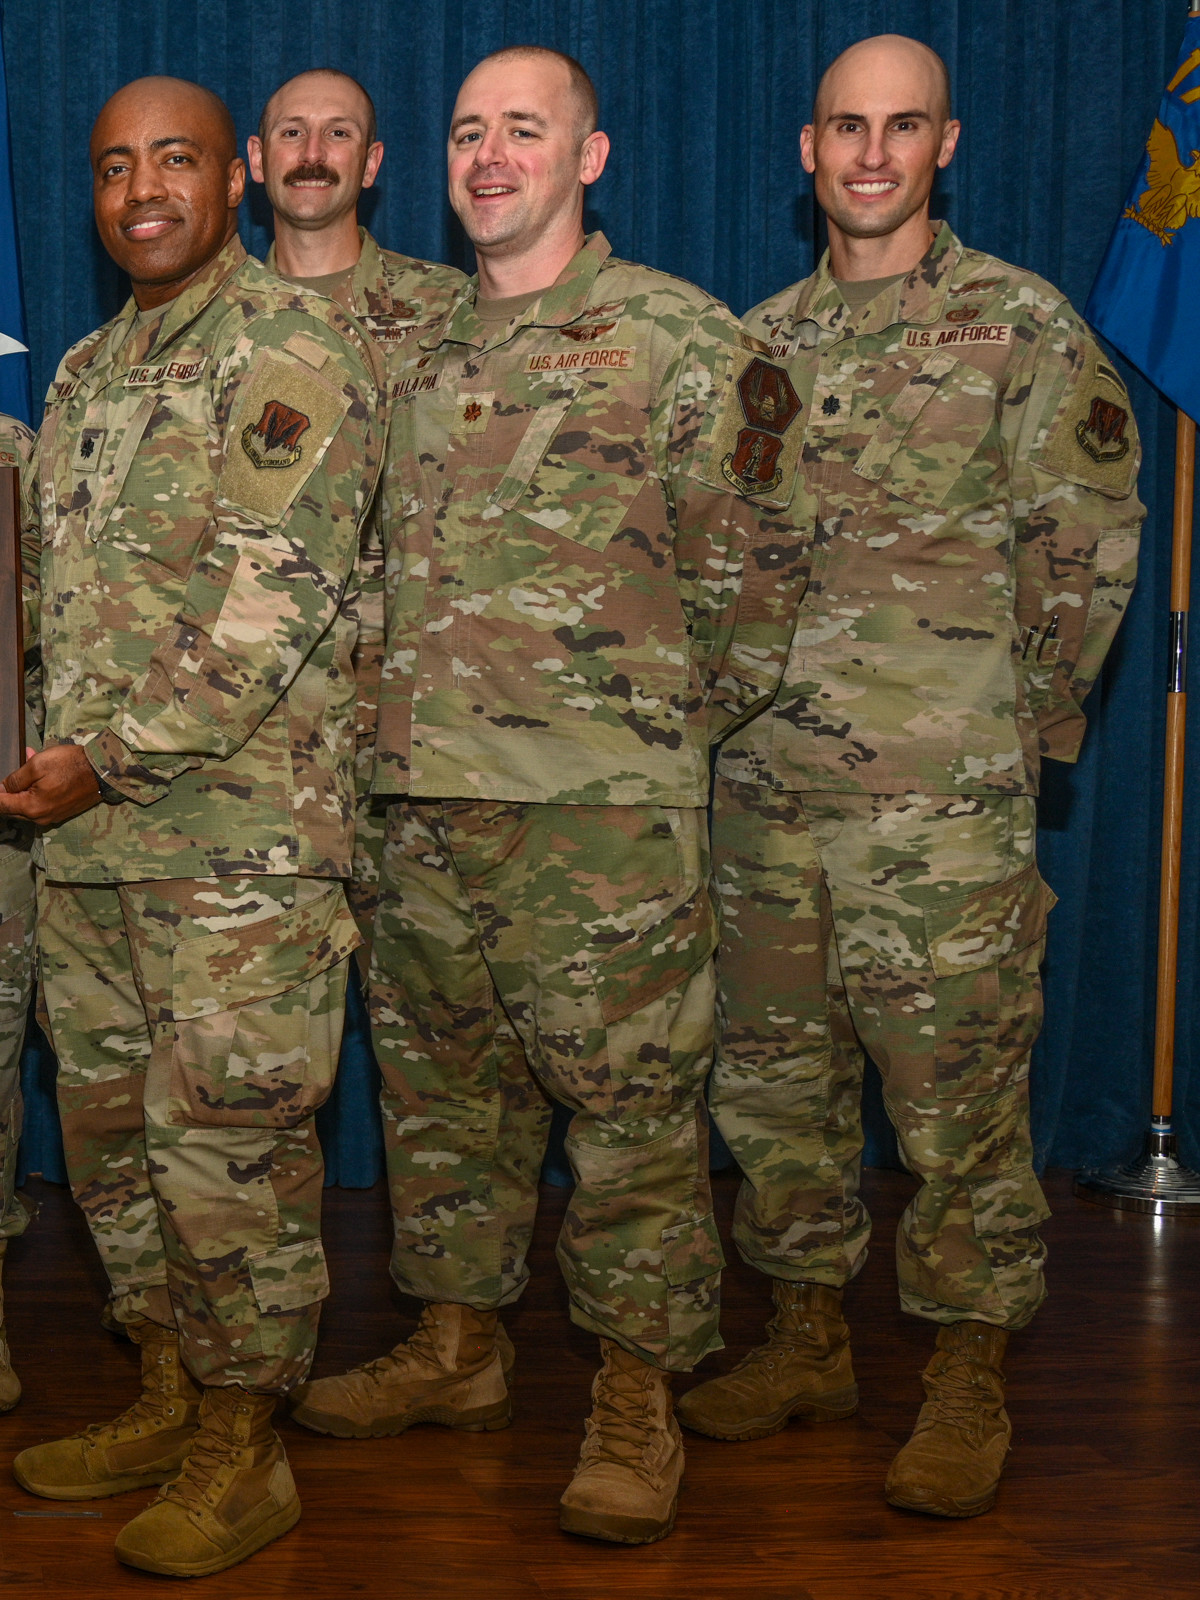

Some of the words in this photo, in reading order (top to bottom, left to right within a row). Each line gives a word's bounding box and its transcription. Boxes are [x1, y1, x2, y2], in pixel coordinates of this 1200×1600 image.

[906, 330, 931, 347] U.S.
[935, 329, 960, 346] AIR
[960, 325, 1008, 342] FORCE
[529, 354, 552, 371] U.S.
[554, 353, 580, 369] AIR
[580, 349, 631, 368] FORCE
[128, 367, 150, 384] U.S.
